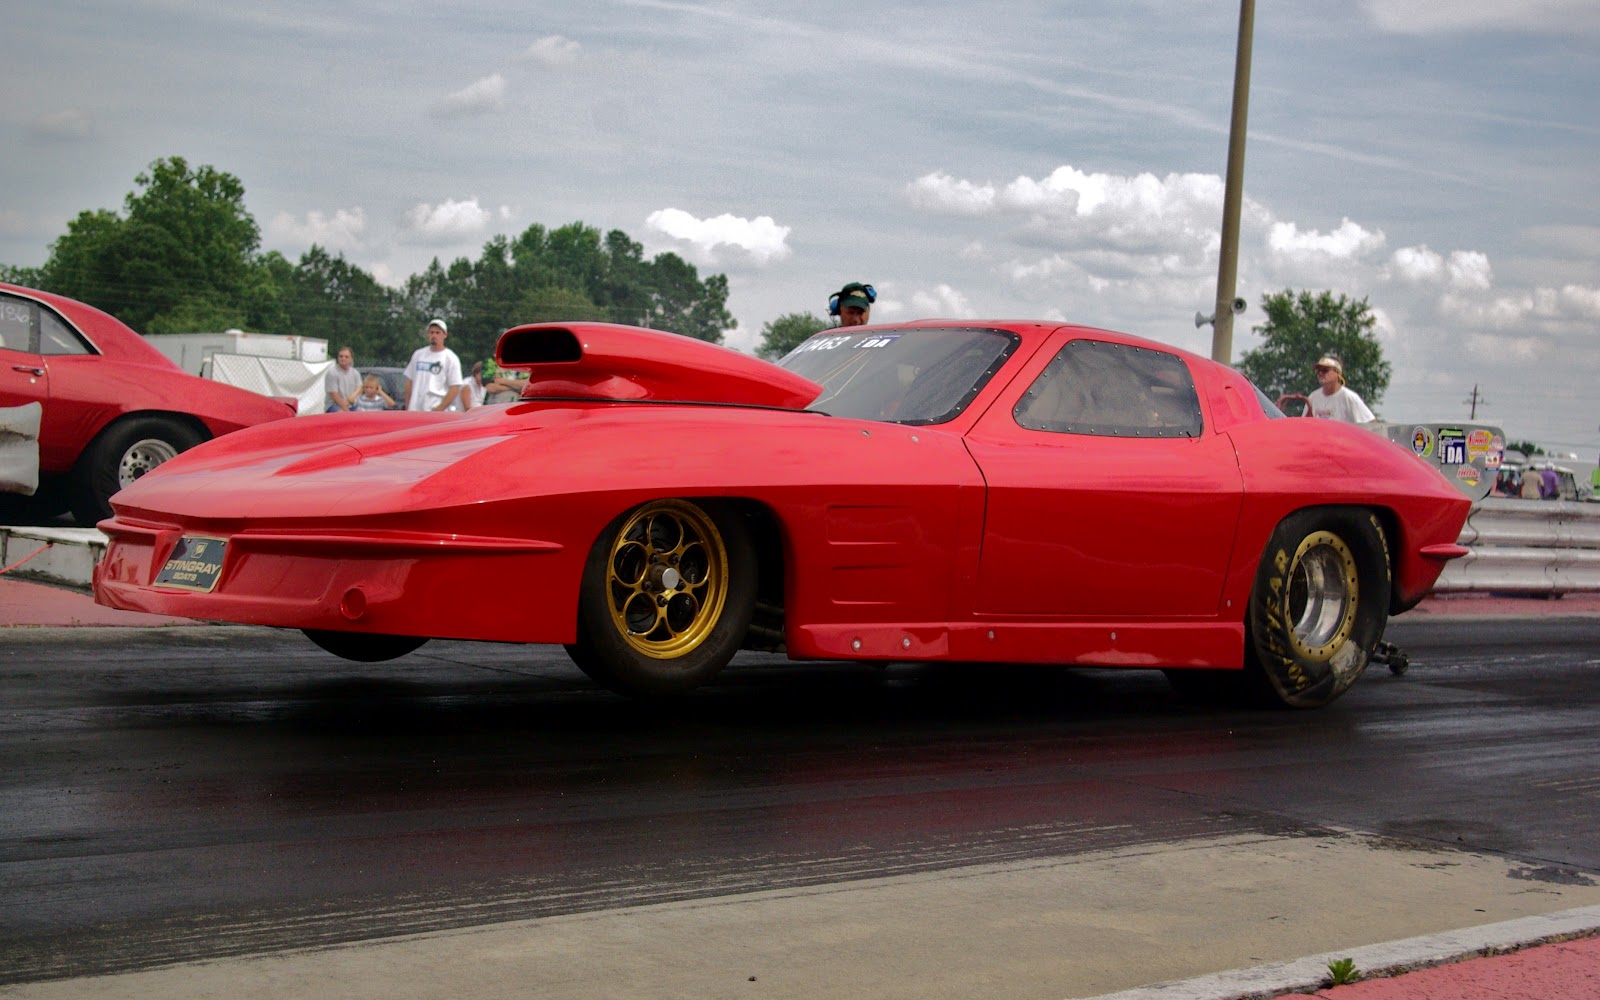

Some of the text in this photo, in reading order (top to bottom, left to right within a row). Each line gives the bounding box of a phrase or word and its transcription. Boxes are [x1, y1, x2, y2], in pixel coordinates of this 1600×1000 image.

[1447, 446, 1463, 464] DA
[165, 560, 221, 574] STINGRAY
[173, 572, 197, 581] BOATS
